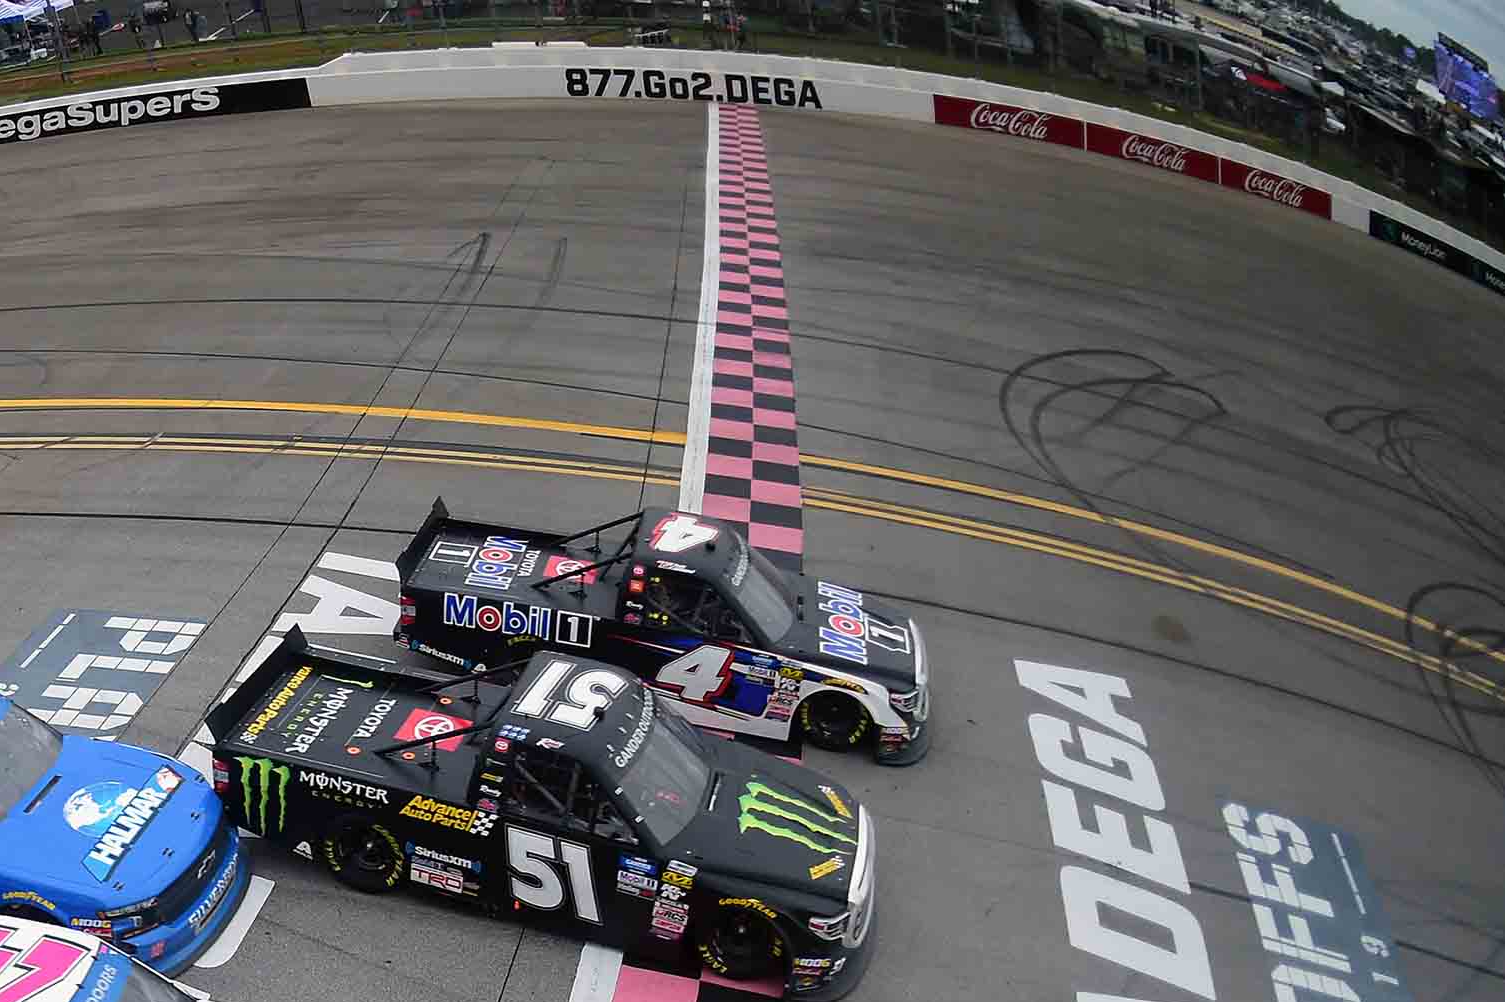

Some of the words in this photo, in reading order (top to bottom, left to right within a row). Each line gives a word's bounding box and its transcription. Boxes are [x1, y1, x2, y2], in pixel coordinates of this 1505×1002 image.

[564, 67, 823, 110] 877.Go2.DEGA
[970, 103, 1048, 140] Coca-Cola
[1121, 134, 1187, 172] Coca-Cola
[1244, 169, 1303, 207] Coca-Cola
[465, 535, 528, 590] Mobil
[516, 549, 542, 578] TOYOTA
[444, 593, 552, 641] Mobil
[817, 581, 869, 666] Mobil
[510, 658, 629, 731] 51
[655, 645, 733, 702] 4
[285, 687, 355, 753] MONSTER
[352, 698, 398, 740] TOYOTA
[299, 769, 390, 805] MONSTER
[410, 794, 471, 821] Advance
[89, 787, 167, 866] HALMAR
[399, 805, 432, 824] Auto
[431, 812, 467, 832] Parts
[506, 823, 604, 926] 51
[718, 897, 778, 919] GOODYEAR
